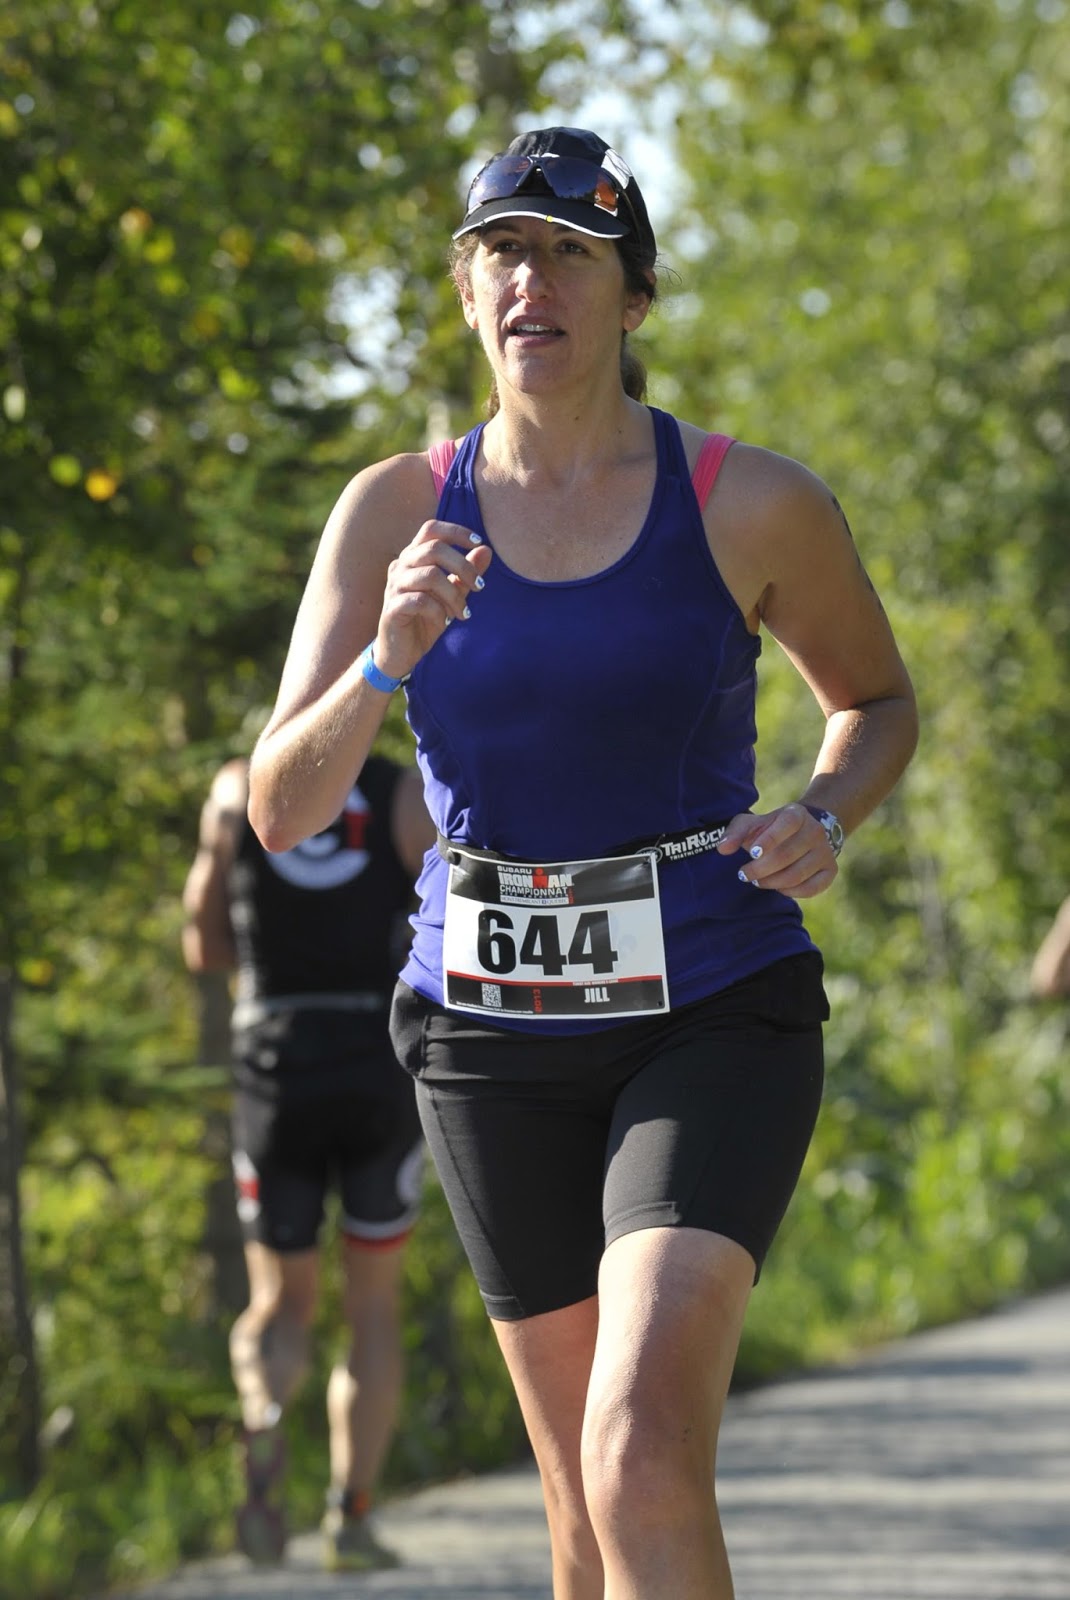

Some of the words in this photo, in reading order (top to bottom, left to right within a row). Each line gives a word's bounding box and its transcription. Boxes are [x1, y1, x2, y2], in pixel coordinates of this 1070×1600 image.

[670, 848, 703, 861] TRIATHLON
[497, 865, 532, 874] SUBARU
[498, 868, 573, 888] IRONMAN
[499, 885, 568, 896] CHAMPIONNAT
[477, 909, 618, 976] 644
[532, 988, 543, 1013] 2013
[584, 986, 611, 1003] JILL
